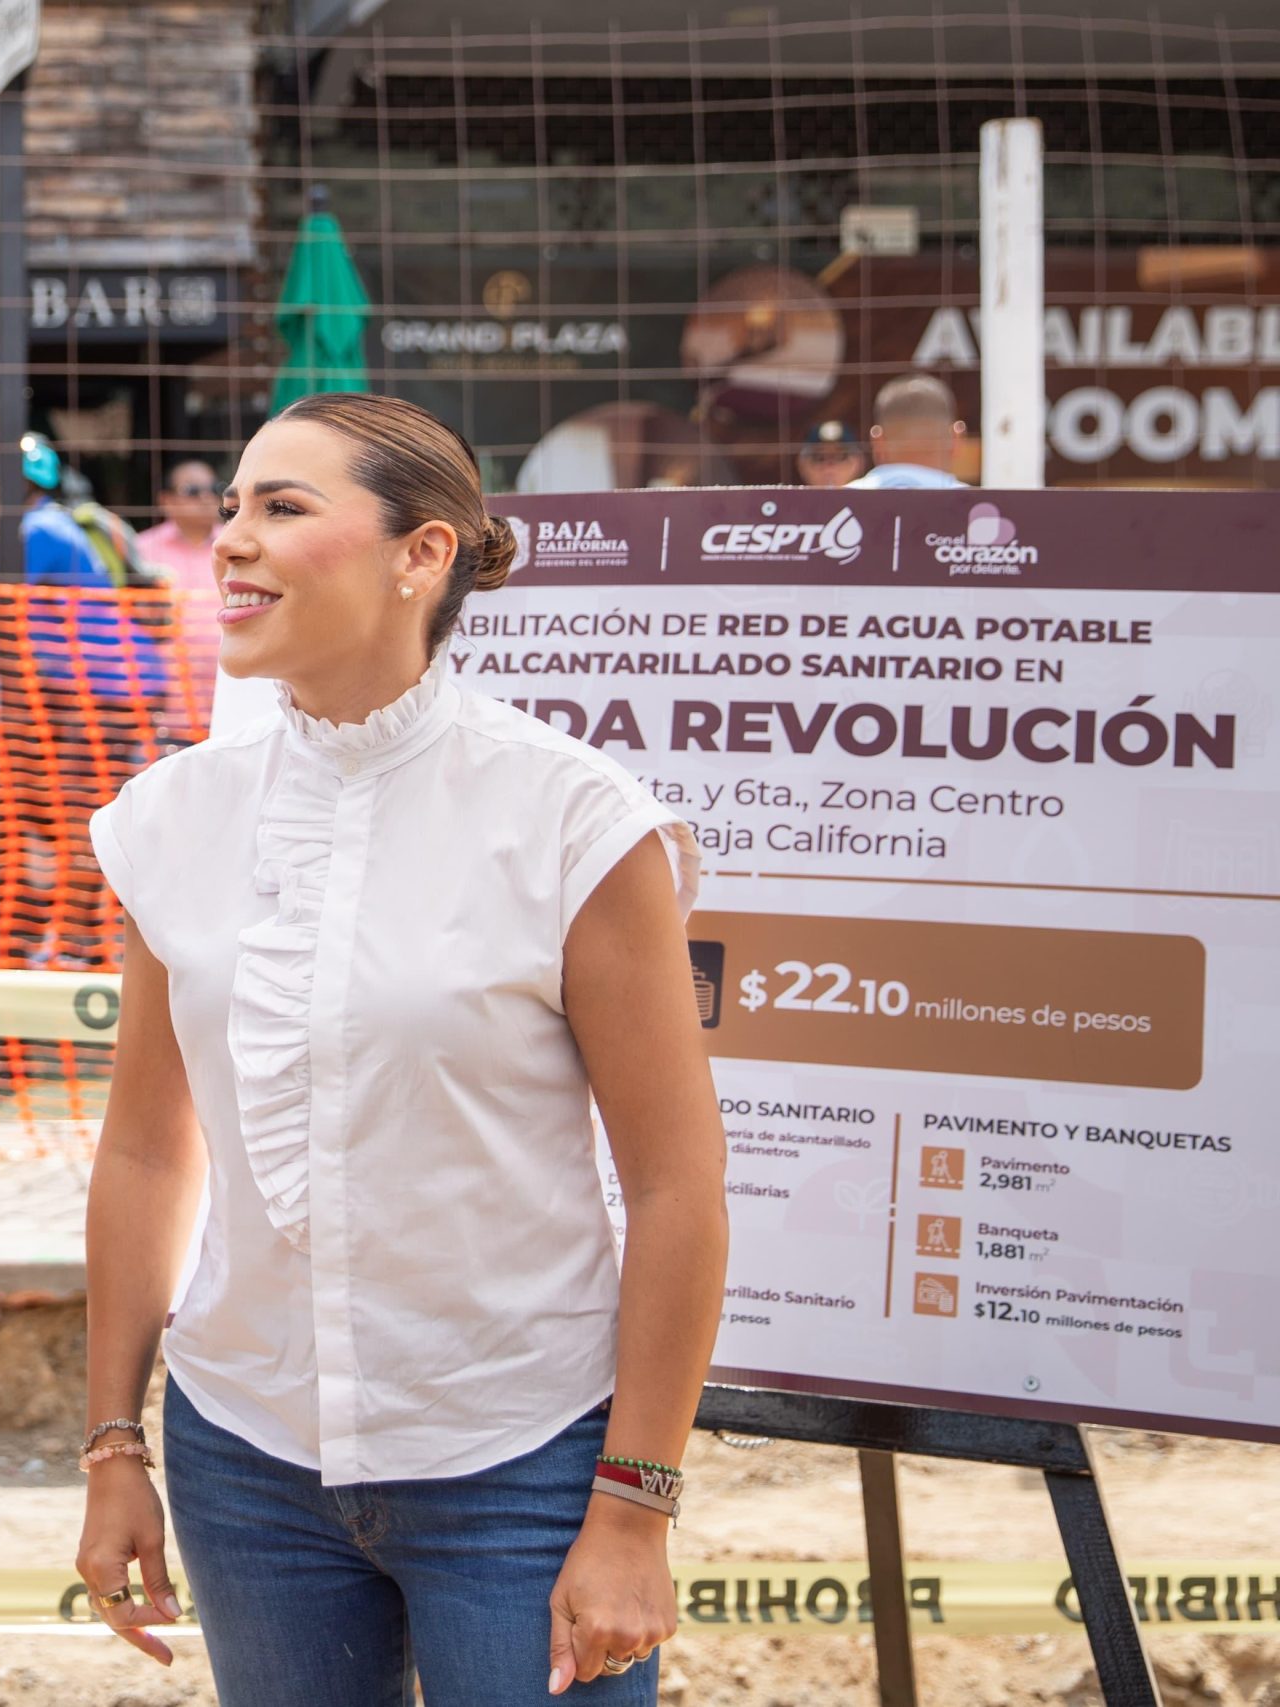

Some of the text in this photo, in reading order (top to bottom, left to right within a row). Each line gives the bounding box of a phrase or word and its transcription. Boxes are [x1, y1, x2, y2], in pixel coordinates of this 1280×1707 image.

[31, 276, 166, 328] BAR
[381, 320, 628, 354] GRAND PLAZA
[1043, 386, 1280, 464] OOM
[538, 521, 604, 540] BAJA
[701, 524, 825, 553] CESPT
[536, 540, 629, 553] CALIFORNIA
[935, 541, 1038, 564] corazón
[662, 614, 707, 636] DE
[717, 614, 789, 637] RED
[799, 615, 848, 638] DE
[858, 616, 964, 640] AGUA
[976, 617, 1152, 644] POTABLE
[450, 652, 1063, 683] Y ALCANTARILLADO SANITARIO EN
[670, 695, 1235, 769] REVOLUCIÓN
[702, 783, 724, 811] y
[735, 779, 809, 812] 6ta.,
[820, 782, 916, 811] Zona
[930, 785, 1064, 817] Centro
[766, 824, 946, 858] California
[915, 998, 1026, 1025] millones
[1031, 1004, 1066, 1028] de
[1073, 1012, 1151, 1033] pesos
[757, 1101, 875, 1124] SANITARIO
[758, 1130, 774, 1141] de
[778, 1132, 871, 1149] alcantarillado
[923, 1113, 1232, 1152] PAVIMENTO Y BANQUETAS
[731, 1144, 800, 1158] diámetros
[980, 1156, 1070, 1175] Pavimento
[979, 1173, 1032, 1190] 2,981
[978, 1223, 1059, 1241] Banqueta
[976, 1241, 1025, 1260] 1,881
[784, 1290, 856, 1310] Sanitario
[975, 1281, 1184, 1313] Inversión Pavimentación
[730, 1312, 771, 1325] pesos
[974, 1301, 1183, 1339] $12.10 millones de pesos
